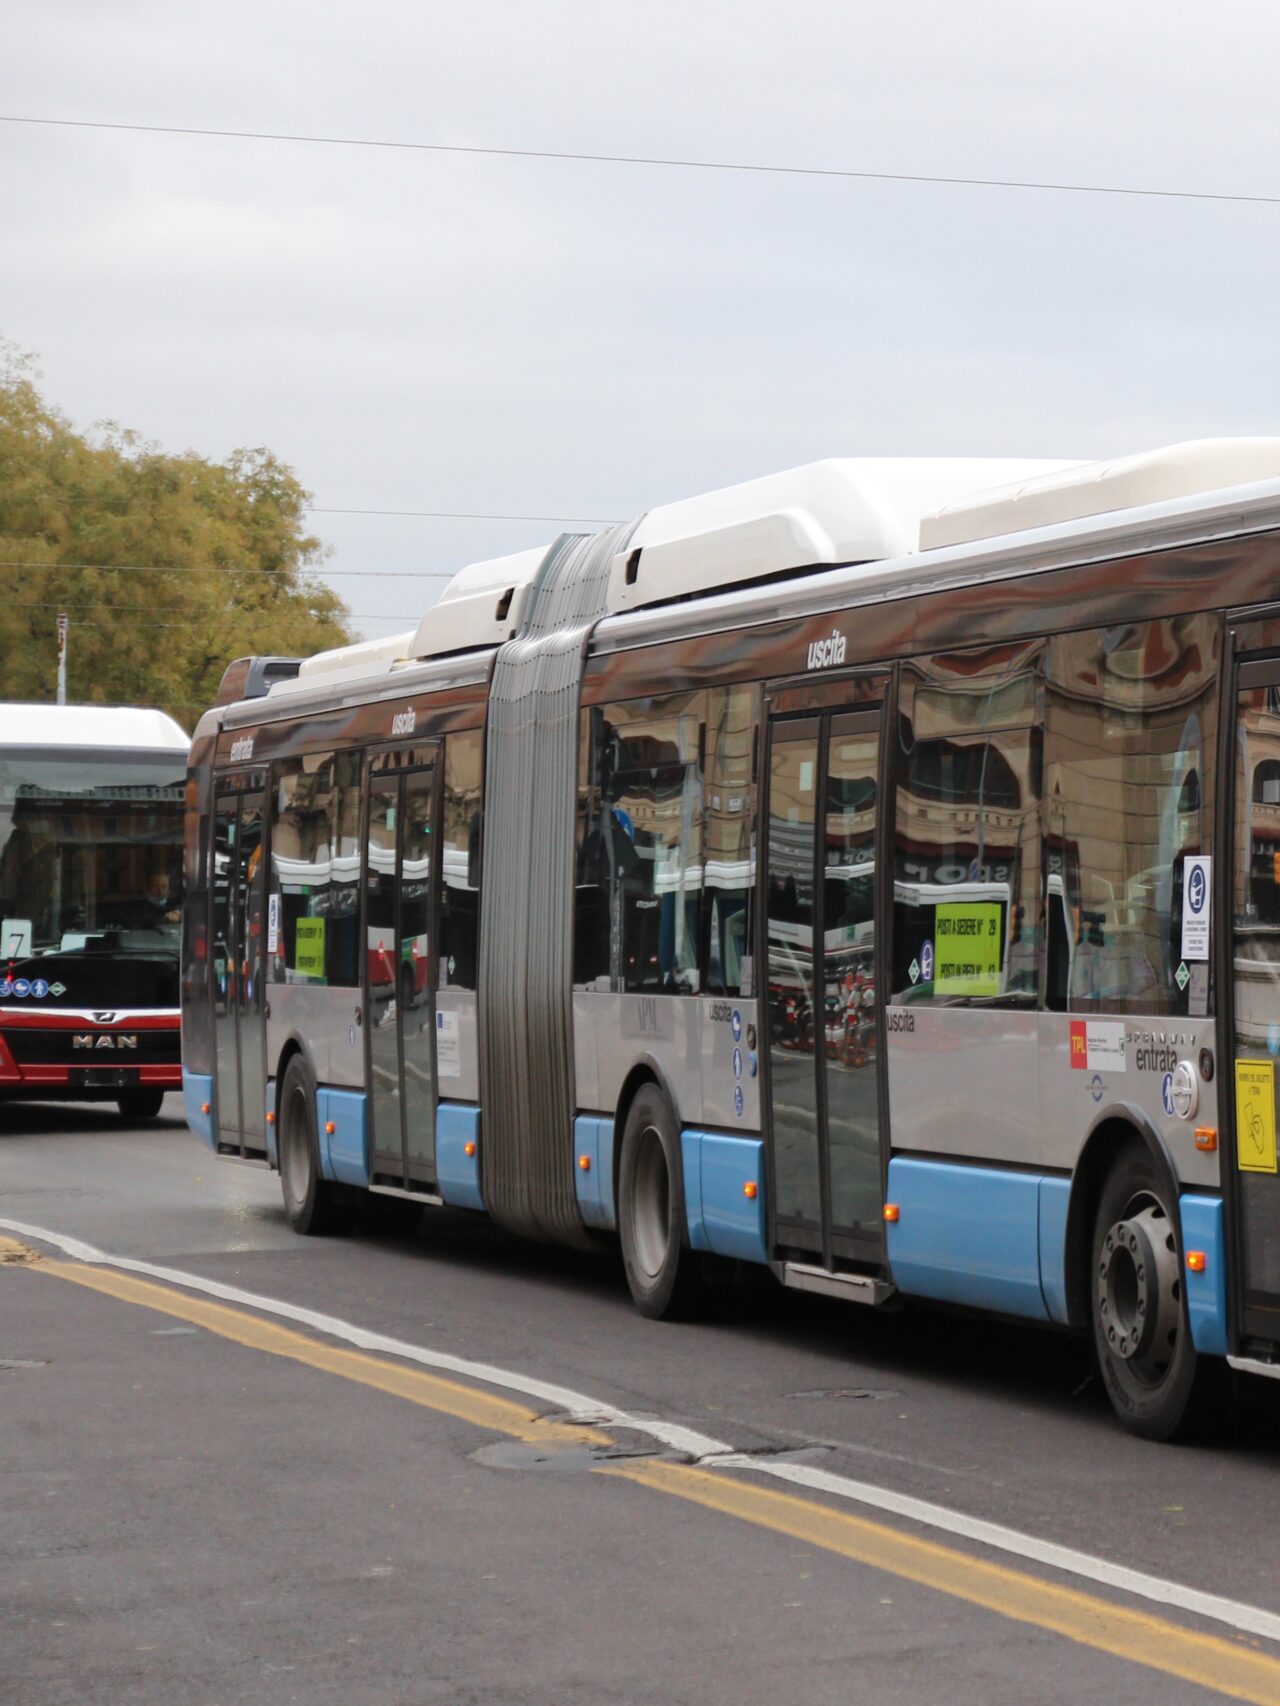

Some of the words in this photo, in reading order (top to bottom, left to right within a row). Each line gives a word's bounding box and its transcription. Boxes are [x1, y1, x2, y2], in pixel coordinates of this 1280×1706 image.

[807, 629, 847, 670] uscita
[391, 706, 416, 735] uscita
[886, 1007, 915, 1032] uscita
[72, 1035, 138, 1049] MAN
[1071, 1035, 1086, 1054] TPL
[1136, 1044, 1178, 1073] entrata
